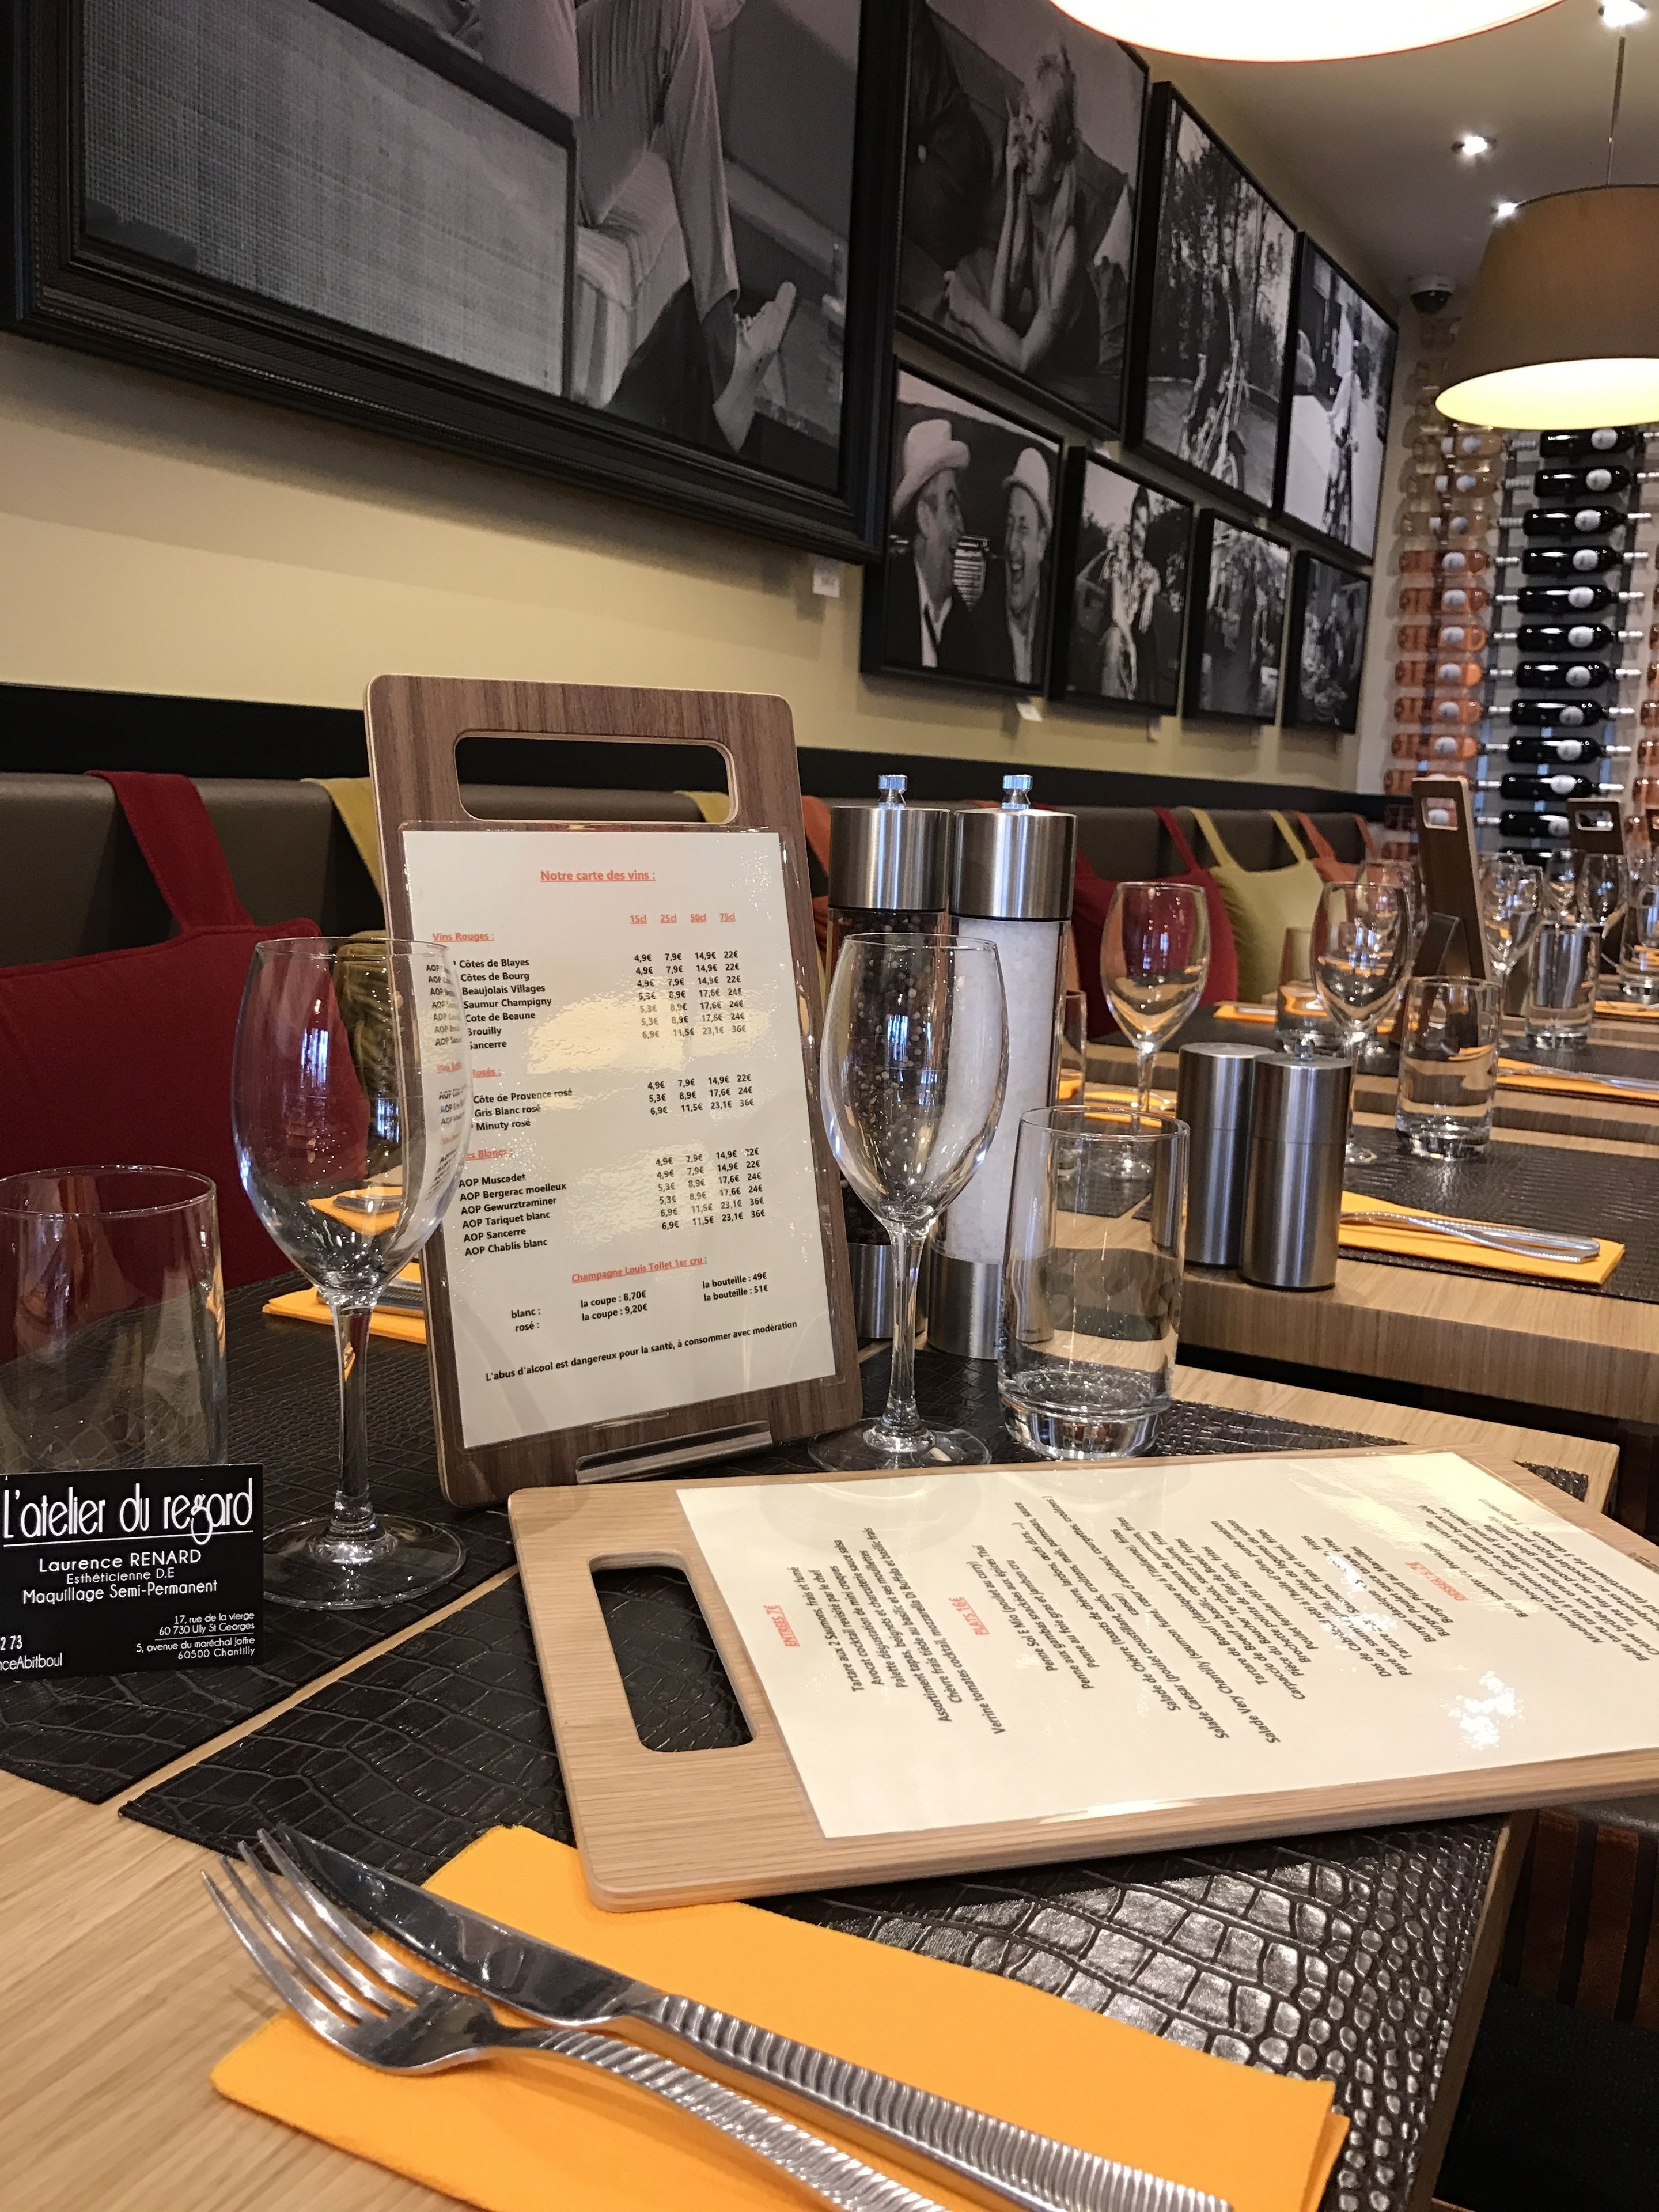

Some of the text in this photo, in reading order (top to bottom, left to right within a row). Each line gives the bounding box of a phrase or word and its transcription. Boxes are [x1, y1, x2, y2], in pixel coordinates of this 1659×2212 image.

[540, 870, 650, 882] Notre carte des vins
[630, 913, 735, 924] 15cl 25cl 50cl 75cl
[433, 933, 490, 942] Vins Rouges
[459, 950, 738, 968] Côtes de Blayes 4,9€ 7,9€ 14,9€ 22€
[460, 963, 740, 982] Côtes de Bourg 4,9€ 7,9€ 14,9€ 22€
[462, 984, 546, 997] Beaujolais Villages
[463, 997, 552, 1009] Saumur Champigny
[465, 1012, 536, 1022] Cote de Beaune
[474, 1104, 541, 1118] Gris Blanc rosé
[476, 1118, 531, 1131] Minuty rosé
[459, 1173, 527, 1188] AOP Muscadet
[460, 1183, 567, 1202] AOP Bergerac moelleux
[461, 1198, 556, 1215] AOP Gewurztraminer
[463, 1211, 551, 1229] AOP Tariquet blanc
[464, 1229, 526, 1243] AOP Sancerre
[465, 1209, 766, 1256] AOP Chablis blanc 6,9€ 11,5€ 23,1€ 36€
[571, 1257, 703, 1283] Champagne Louis Tollet 1er cru
[511, 1271, 767, 1319] blanc la coupe 8,70€ la bouteille 49€
[515, 1284, 768, 1332] rosé la coupe 9,20€ la bouteille 51€
[486, 1321, 797, 1381] L'abus d'alcool est dangereux pour la santé, à consommer avec modération
[4, 1478, 253, 1545] L'atelier du regard
[40, 1549, 201, 1573] Laurence RENARD
[67, 1567, 174, 1585] Esthéticienne D.E
[787, 1567, 806, 1584] fumé
[808, 1570, 826, 1583] chef
[966, 1561, 988, 1580] curry)
[24, 1579, 217, 1604] Maquillage Semi-Permanent
[982, 1580, 995, 1589] au
[802, 1592, 819, 1607] frais
[824, 1590, 840, 1603] par
[988, 1589, 1016, 1613] (poulet
[1201, 1546, 1319, 1650] Poulet fermier rôti au thym, frites
[175, 1615, 187, 1626] 17,
[204, 1613, 216, 1622] de
[813, 1607, 838, 1640] Saumons,
[828, 1603, 852, 1627] revisité
[948, 1596, 990, 1635] PLATS 16€
[1008, 1614, 1025, 1628] Mio
[160, 1623, 255, 1635] 60 730 Ully St Georges
[763, 1605, 800, 1647] ENTREES 7€
[10, 1635, 22, 1650] 73
[137, 1643, 143, 1653] 5,
[147, 1643, 178, 1652] avenue
[181, 1641, 191, 1649] du
[193, 1637, 232, 1649] maréchal
[842, 1628, 868, 1657] cocktail
[1021, 1635, 1040, 1647] Sol
[178, 1646, 255, 1659] 60500 Chantilly
[834, 1647, 849, 1661] aux
[1035, 1648, 1059, 1671] Penne
[843, 1663, 865, 1692] Tartare
[860, 1658, 885, 1685] Avocat
